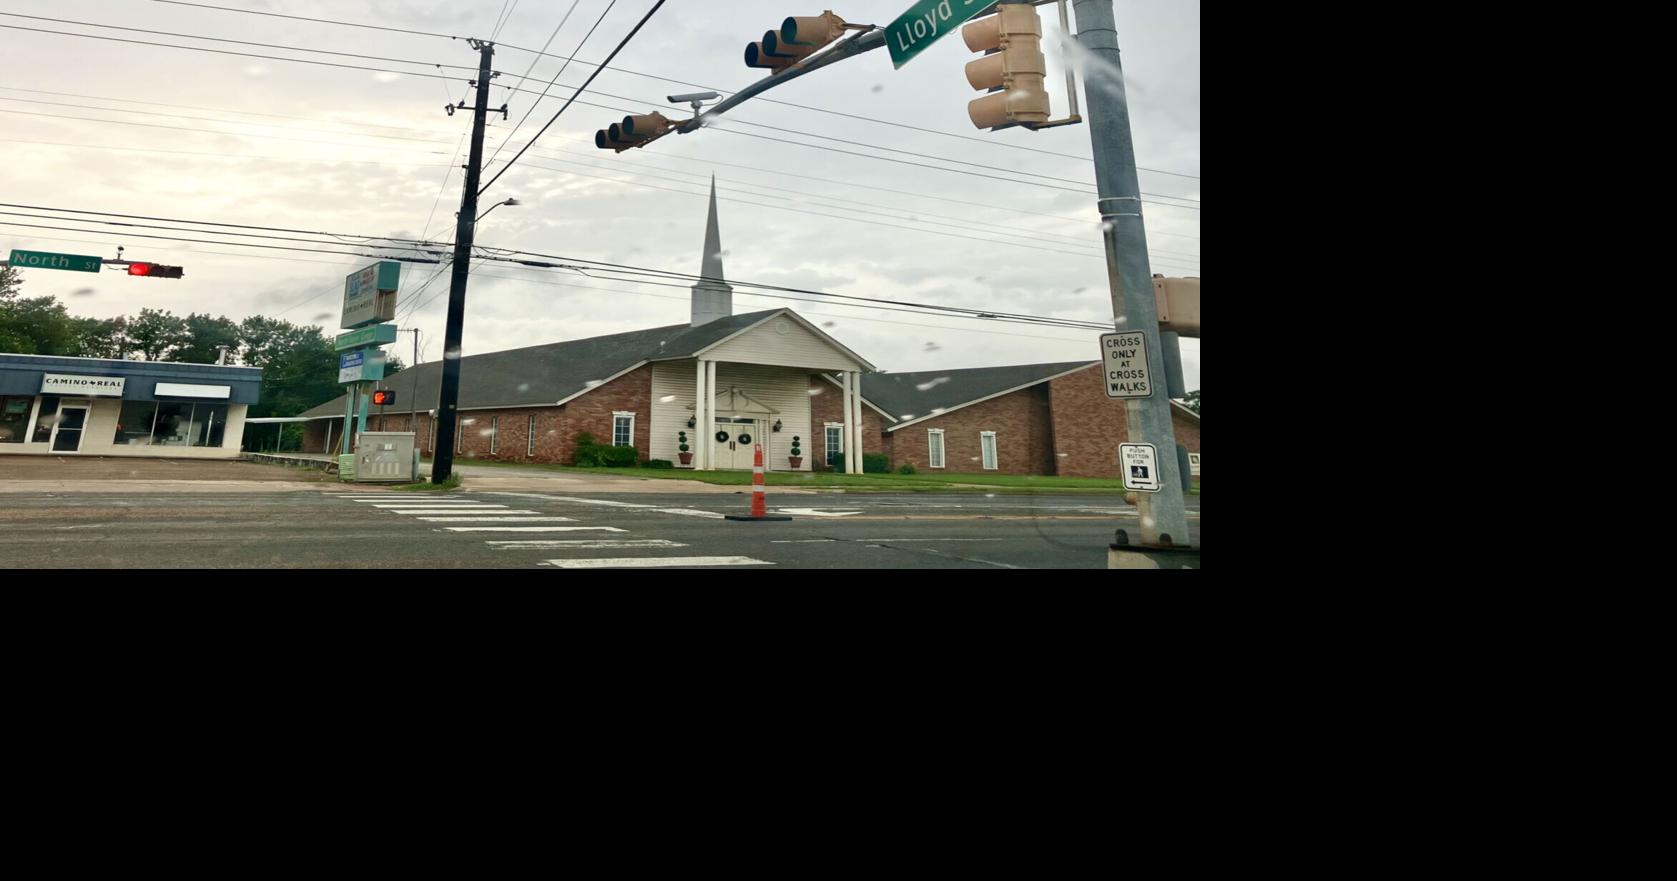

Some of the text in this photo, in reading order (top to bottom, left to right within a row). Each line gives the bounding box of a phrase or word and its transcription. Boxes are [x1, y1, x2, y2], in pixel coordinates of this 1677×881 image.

[897, 0, 952, 51] Lloyd
[14, 253, 97, 270] North St
[1106, 337, 1140, 348] CROSS
[1112, 349, 1136, 359] ONLY
[1110, 369, 1145, 380] CROSS
[46, 378, 88, 386] CAMINO
[1111, 381, 1147, 392] WALKS
